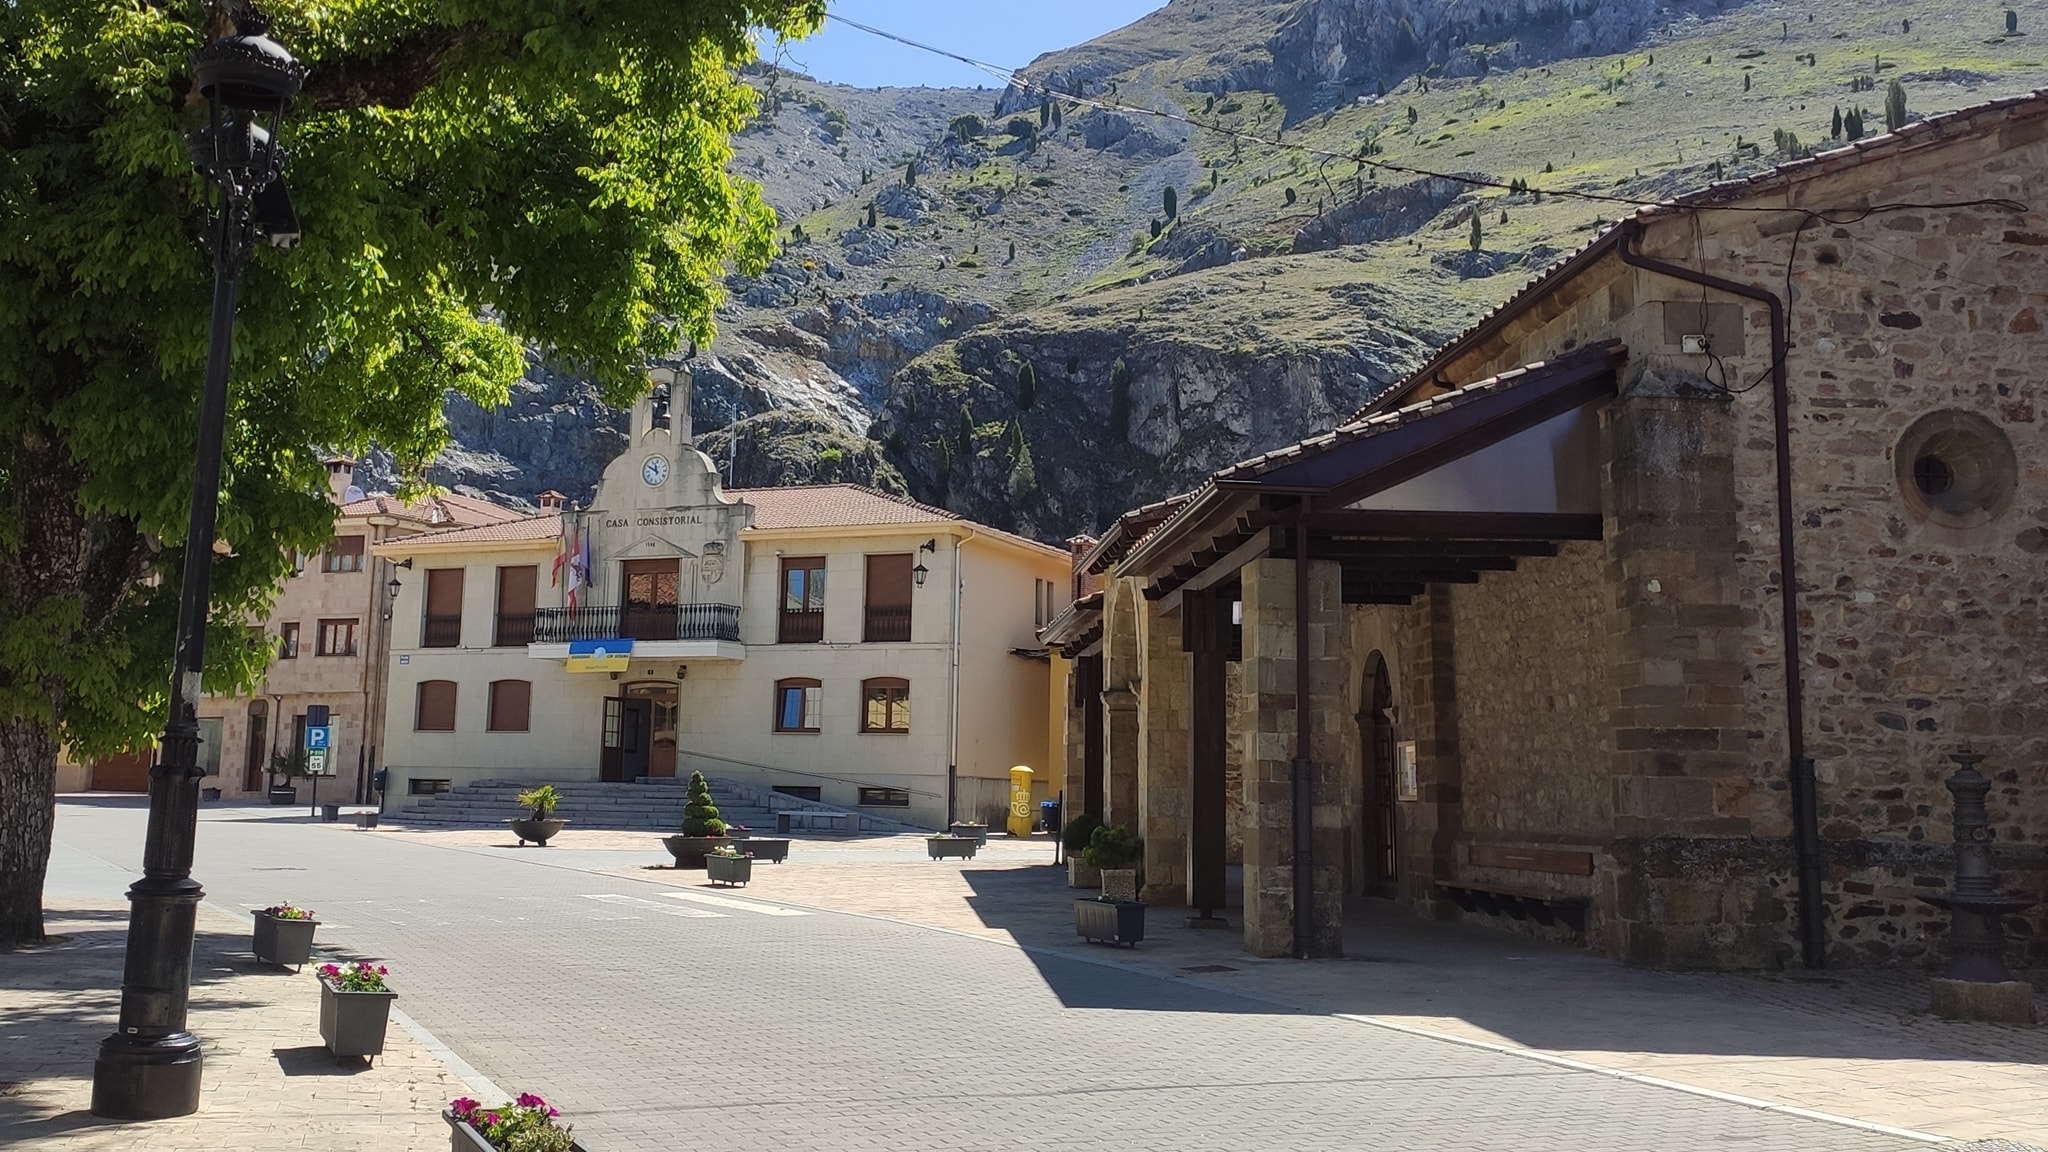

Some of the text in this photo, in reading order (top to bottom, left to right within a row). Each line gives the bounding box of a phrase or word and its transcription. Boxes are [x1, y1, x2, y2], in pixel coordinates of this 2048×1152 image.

[605, 515, 703, 528] CASA CONSISTORIAL
[311, 729, 325, 746] P
